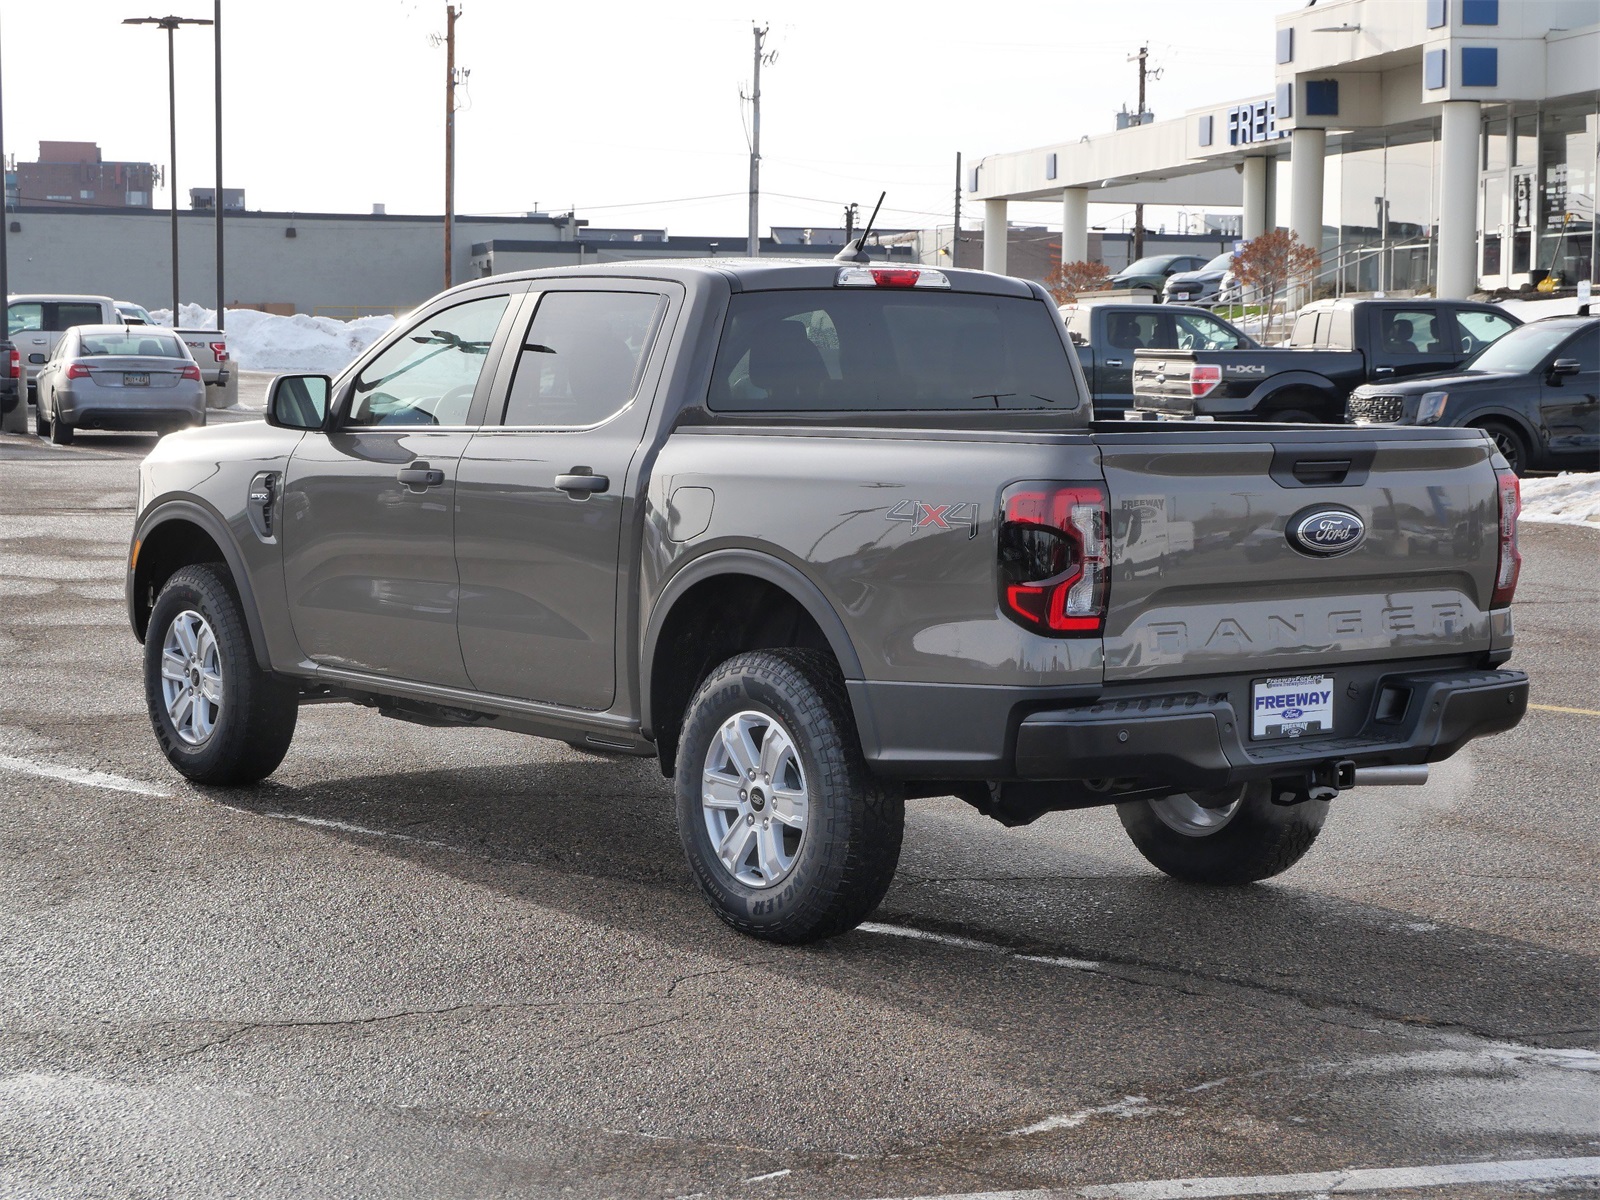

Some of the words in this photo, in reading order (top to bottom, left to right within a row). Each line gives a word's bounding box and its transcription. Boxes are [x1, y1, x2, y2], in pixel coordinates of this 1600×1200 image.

[1227, 100, 1289, 146] FREE
[1121, 499, 1165, 511] FREEWAY
[1315, 519, 1352, 541] Ford
[1147, 603, 1463, 651] RANGER
[1255, 690, 1331, 710] FREEWAY
